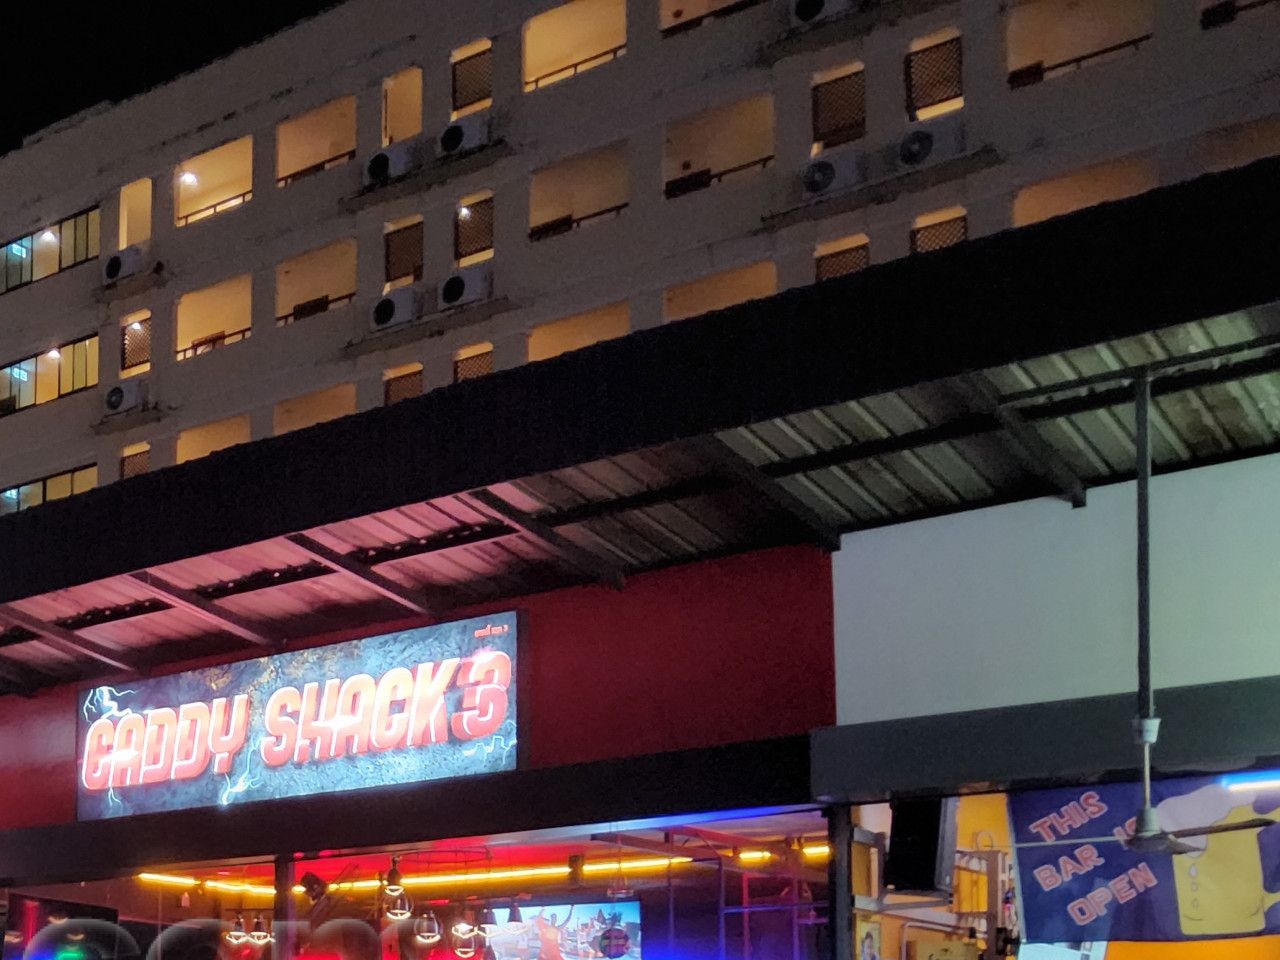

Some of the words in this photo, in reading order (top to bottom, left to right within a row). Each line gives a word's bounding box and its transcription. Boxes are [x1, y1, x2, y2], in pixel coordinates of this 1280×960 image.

[81, 694, 250, 790] CADDY
[260, 657, 460, 768] SHACK
[451, 650, 512, 741] 3
[1029, 791, 1108, 842] THIS
[1033, 844, 1106, 892] BAR
[1066, 862, 1158, 926] OPEN
